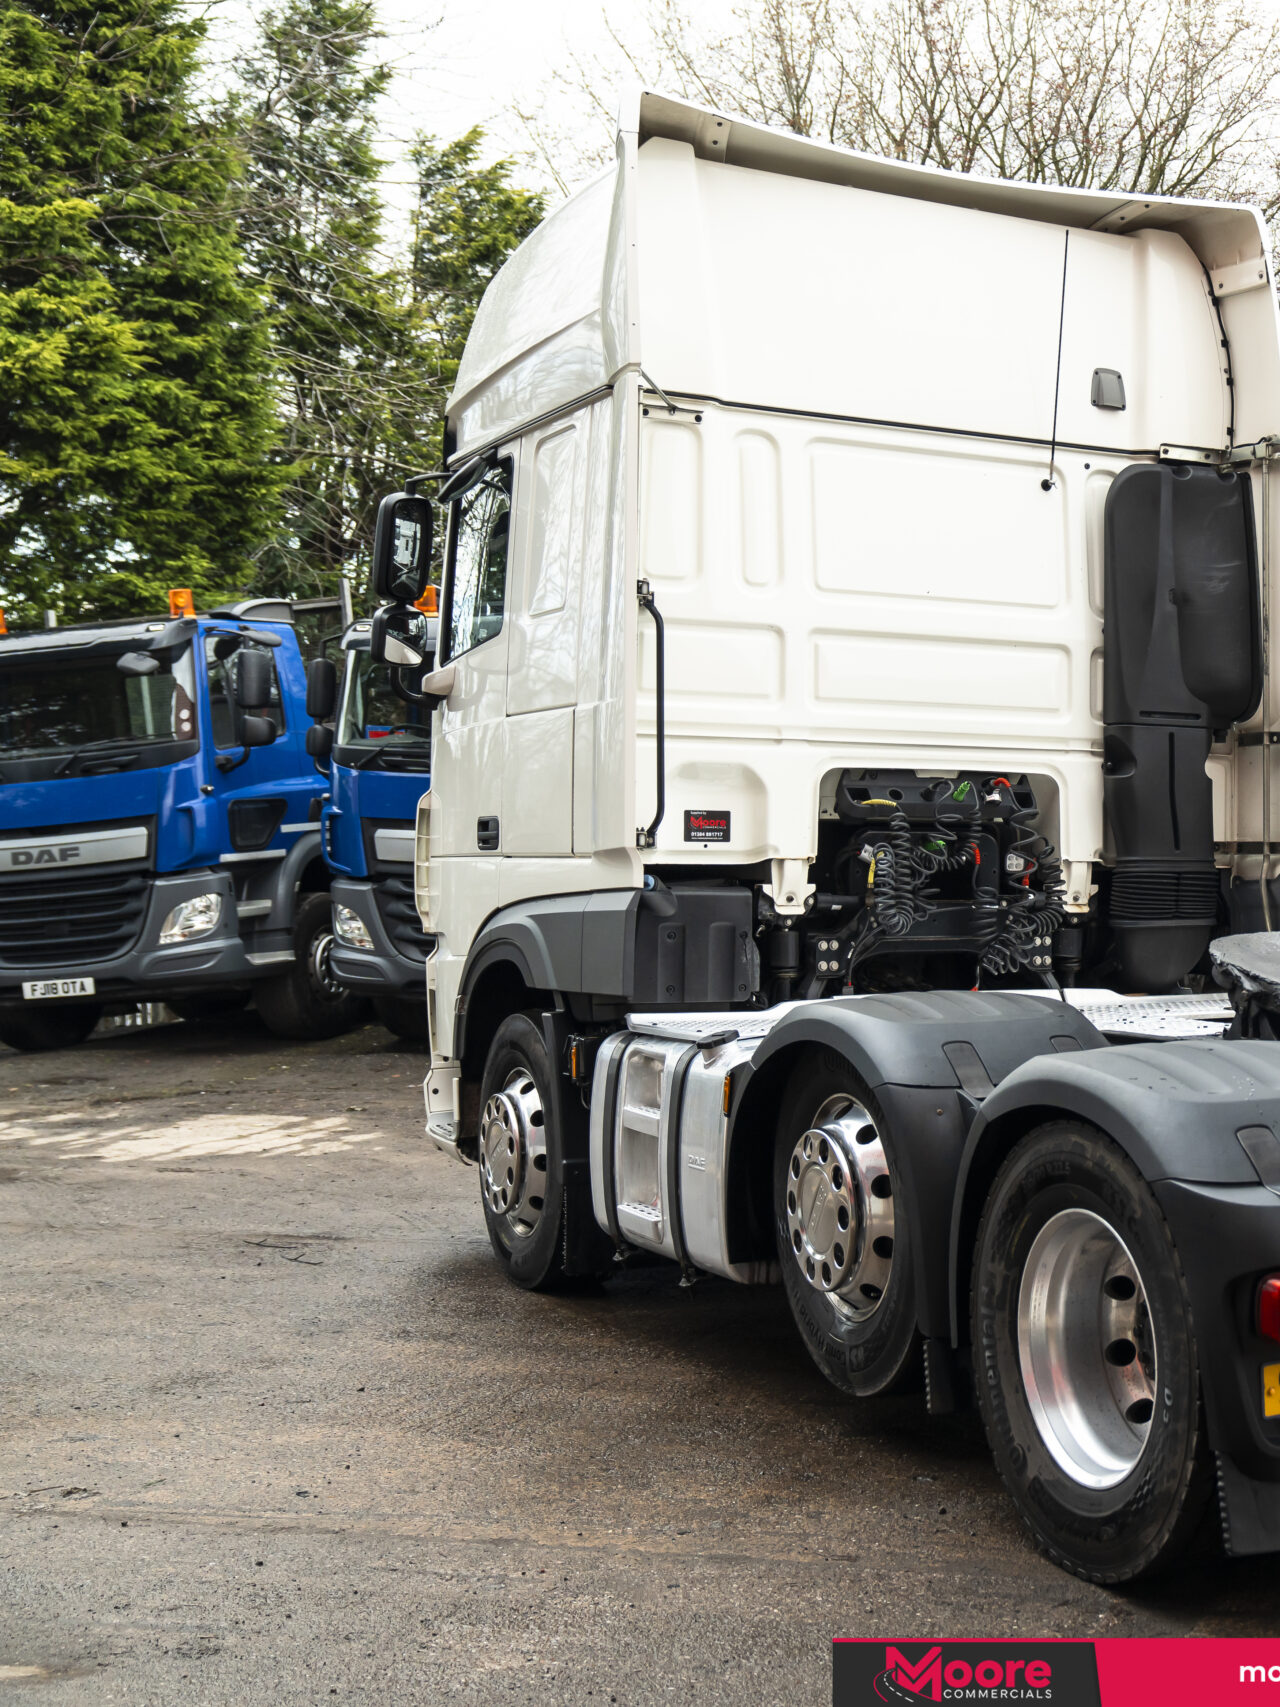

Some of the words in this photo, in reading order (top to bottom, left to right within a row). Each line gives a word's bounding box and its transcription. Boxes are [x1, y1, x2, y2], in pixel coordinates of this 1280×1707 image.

[690, 816, 727, 829] Moore
[11, 847, 80, 866] DAF
[30, 982, 58, 997] FJ18
[61, 980, 87, 995] OTA
